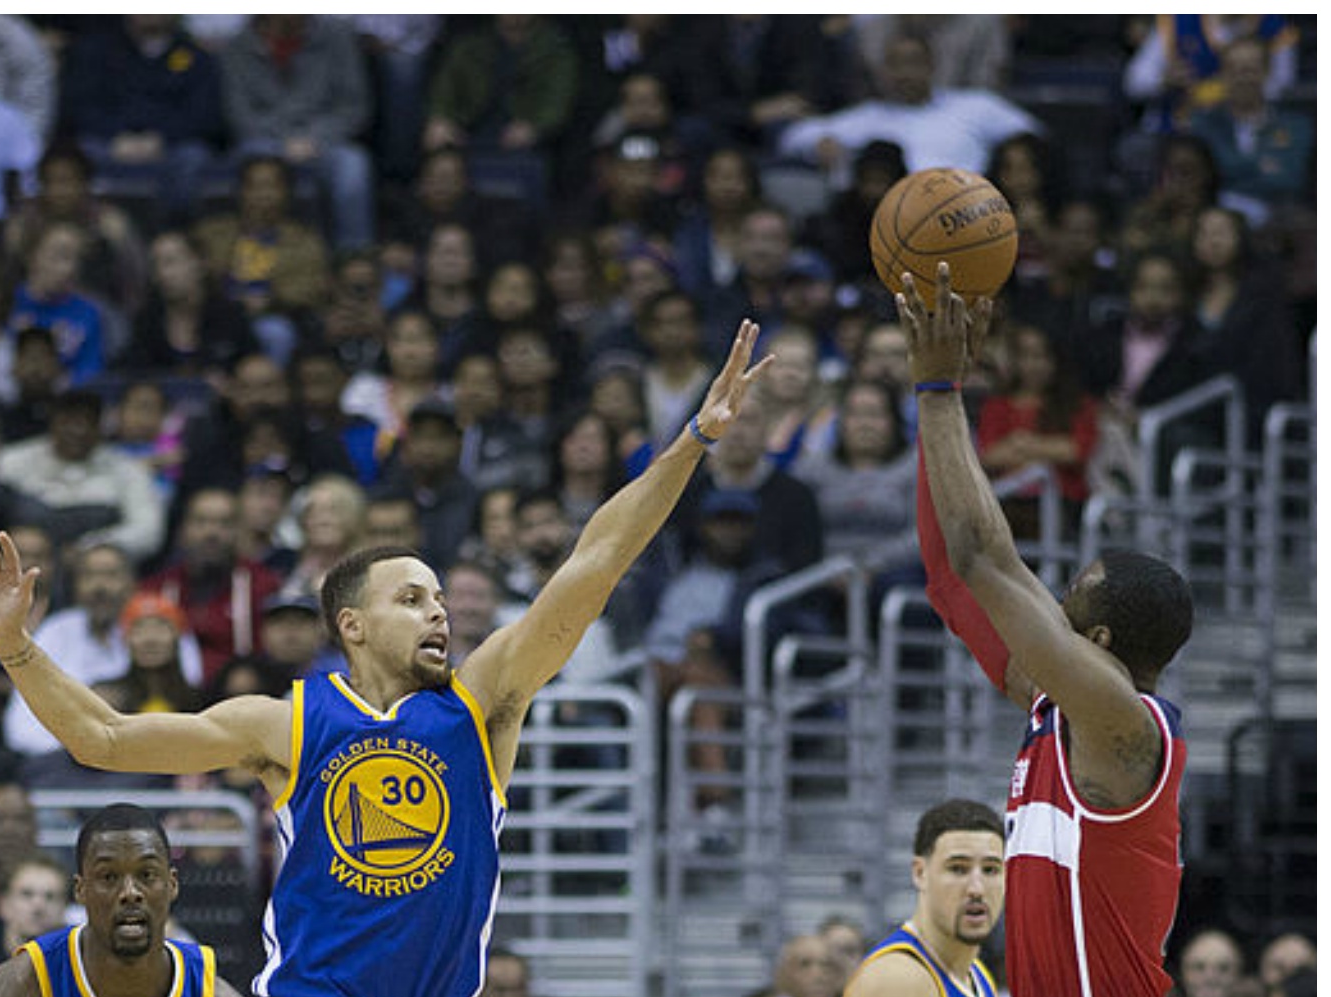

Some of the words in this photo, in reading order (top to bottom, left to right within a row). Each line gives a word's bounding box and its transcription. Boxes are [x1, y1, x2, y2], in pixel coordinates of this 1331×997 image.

[320, 737, 389, 784] GOLDEN
[395, 738, 449, 776] STATE
[380, 774, 426, 806] 30
[328, 847, 456, 898] WARRIORS
